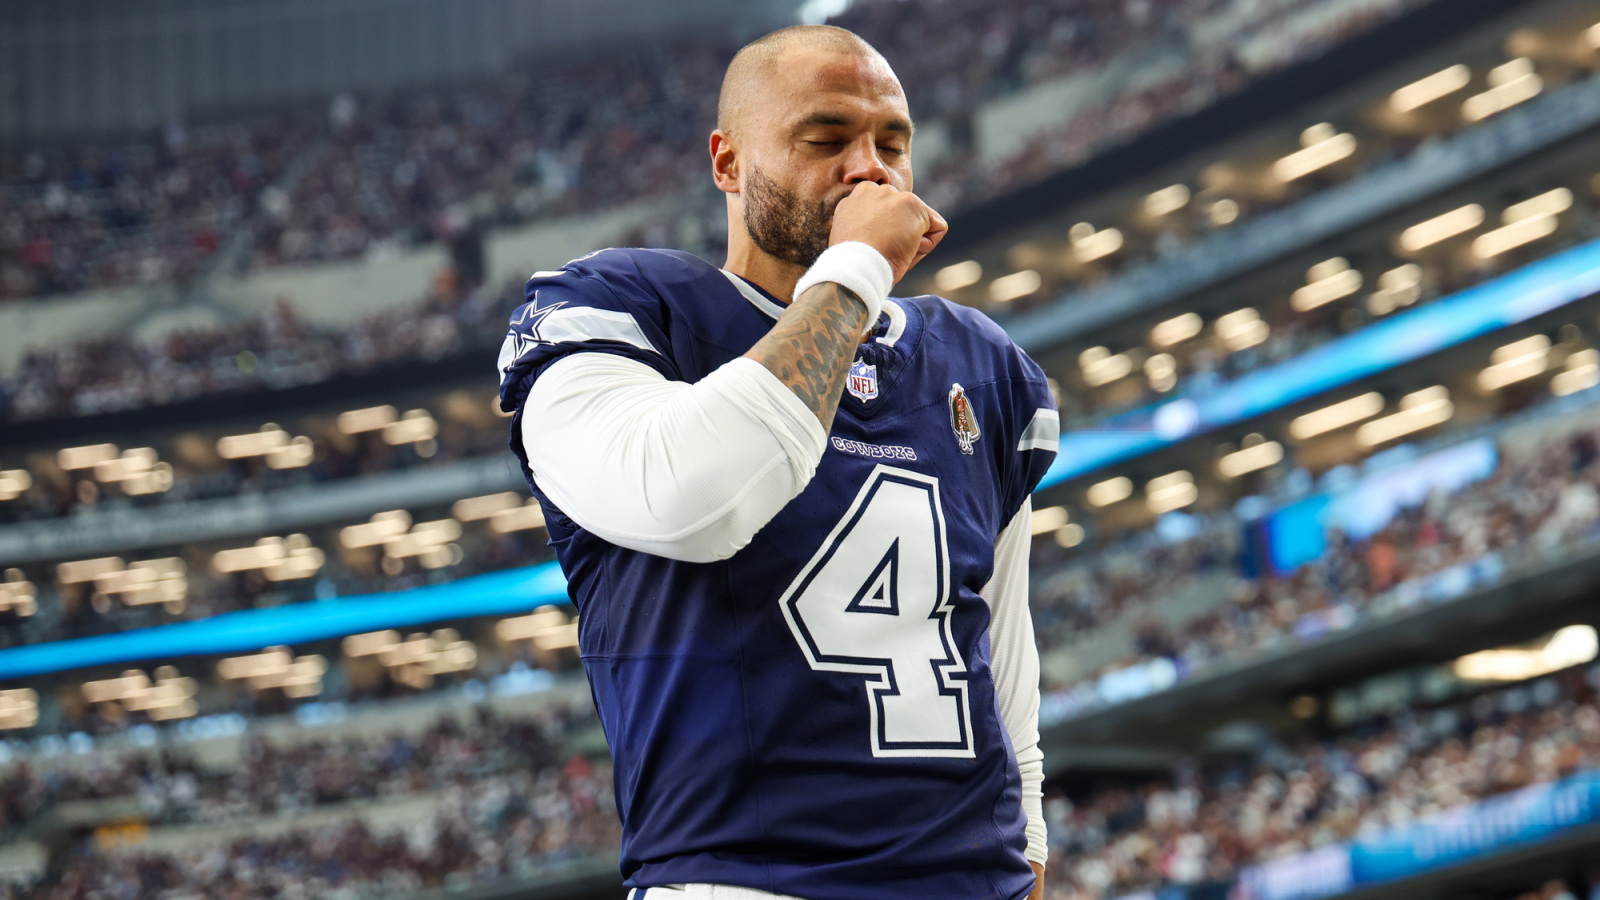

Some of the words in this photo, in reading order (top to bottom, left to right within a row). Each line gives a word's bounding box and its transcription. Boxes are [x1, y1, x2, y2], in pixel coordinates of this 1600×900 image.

[852, 376, 874, 394] NFL
[831, 436, 917, 461] COWBOYS
[778, 463, 976, 758] 4
